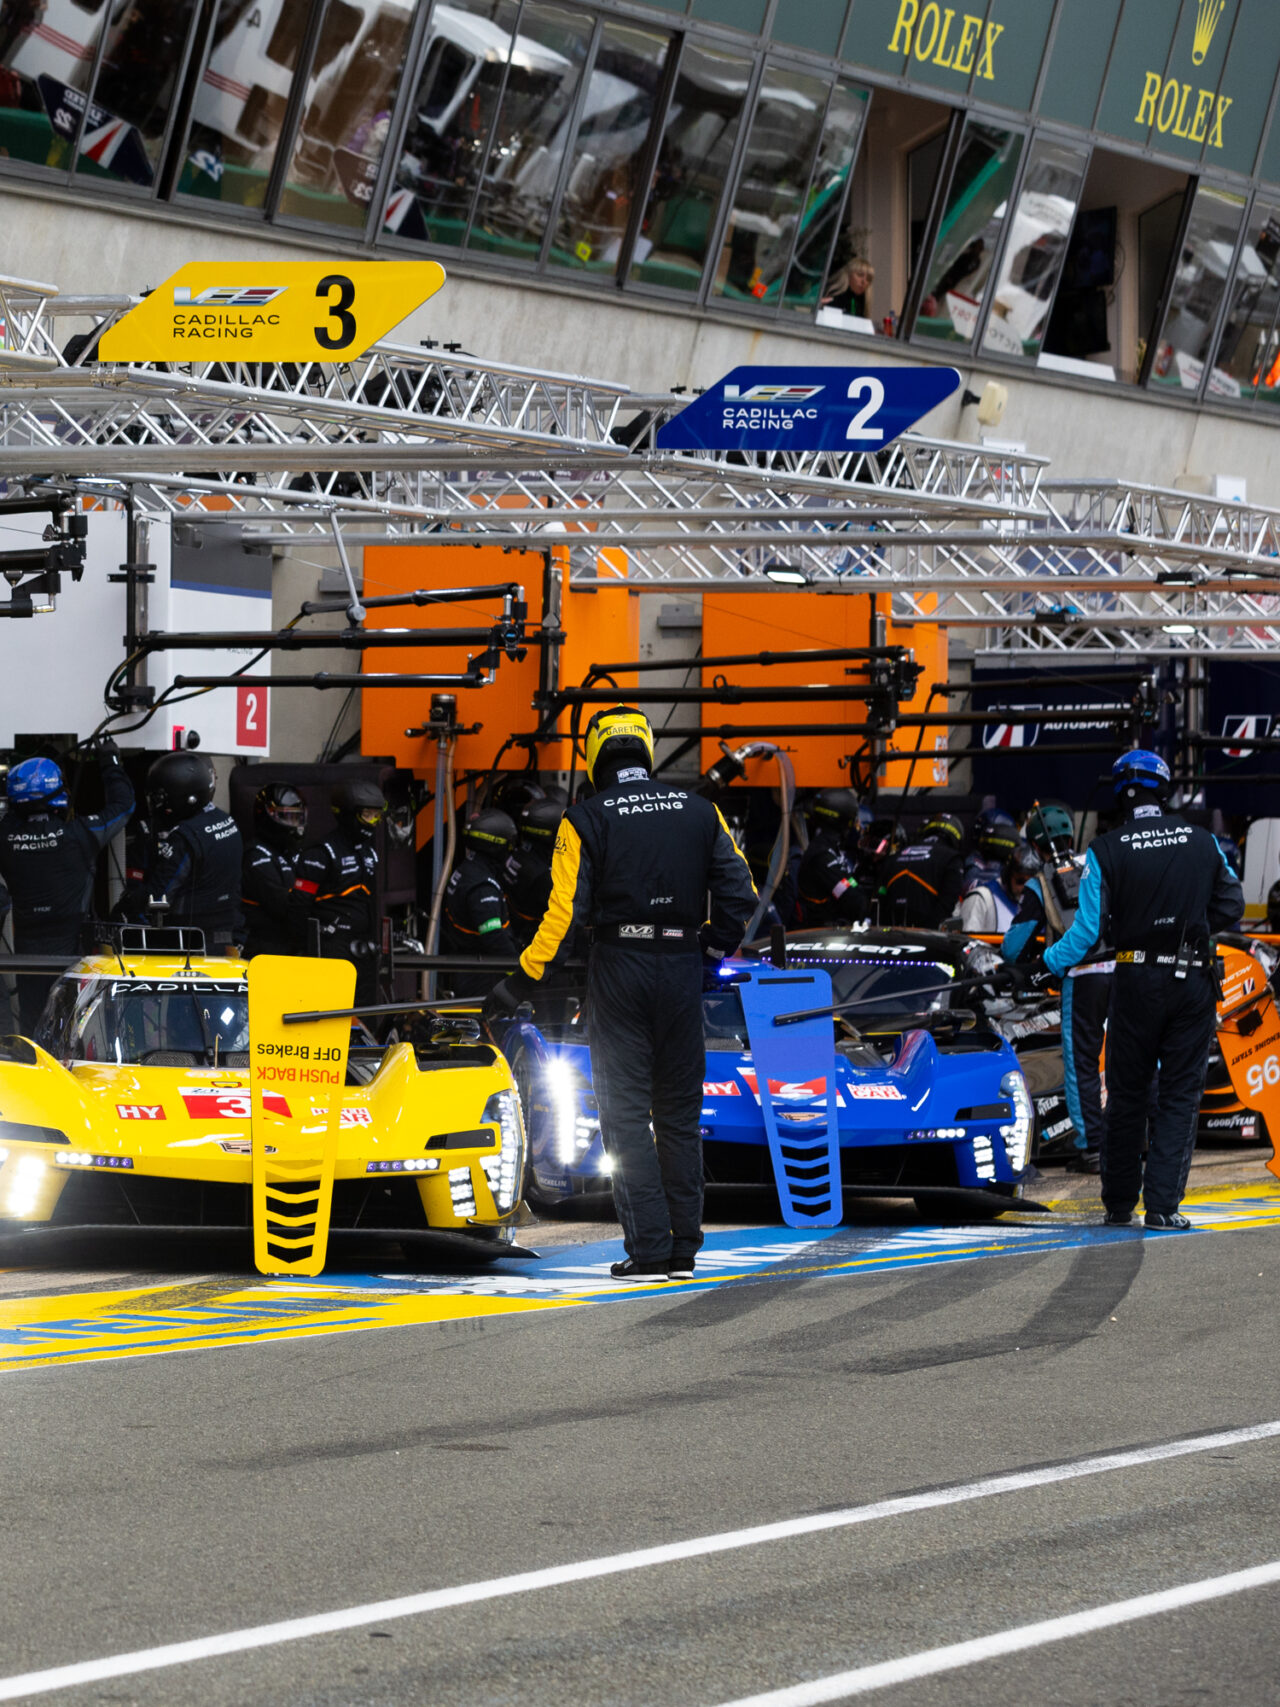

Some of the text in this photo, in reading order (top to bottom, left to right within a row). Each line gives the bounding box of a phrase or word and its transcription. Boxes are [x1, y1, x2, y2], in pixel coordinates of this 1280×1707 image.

[888, 0, 1004, 80] ROLEX
[1136, 71, 1233, 149] ROLEX
[314, 275, 357, 350] 3
[173, 314, 281, 326] CADILLAC
[173, 327, 254, 339] RACING
[722, 407, 818, 419] CADILLAC
[846, 376, 885, 441] 2
[722, 419, 795, 431] RACING
[246, 693, 258, 731] 2
[606, 725, 640, 735] GARETH
[604, 792, 688, 807] CADILLAC
[618, 801, 684, 815] RACING
[8, 829, 64, 841] CADILLAC
[1120, 827, 1193, 842] CADILLAC
[13, 840, 58, 850] RACING
[1132, 835, 1188, 850] RACING
[115, 982, 248, 993] CADILLA
[257, 1043, 341, 1061] OFF Brakes
[1231, 1032, 1280, 1065] ENGINE START
[257, 1066, 339, 1083] PUSH BACK
[1246, 1055, 1280, 1096] 95
[703, 1082, 734, 1095] HY
[853, 1089, 900, 1099] CAR
[120, 1105, 161, 1119] HY
[216, 1096, 252, 1118] 3
[340, 1113, 369, 1123] AR
